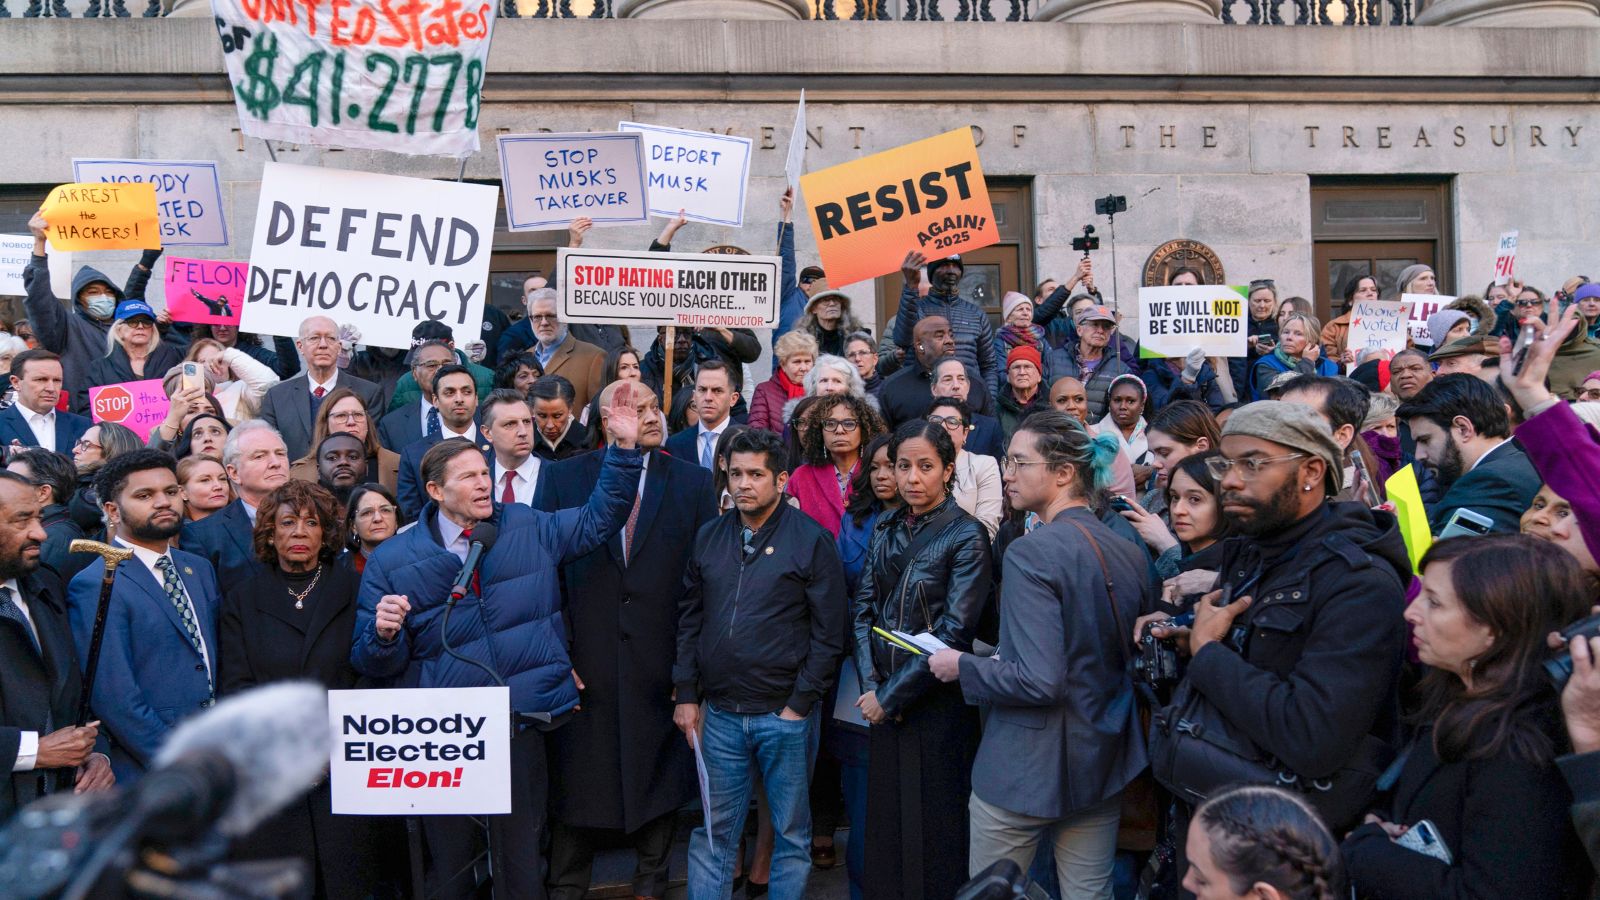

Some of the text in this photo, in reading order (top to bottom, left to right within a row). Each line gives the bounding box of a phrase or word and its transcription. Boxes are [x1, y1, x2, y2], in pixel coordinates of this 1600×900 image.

[1120, 126, 1217, 148] THE
[1304, 126, 1583, 148] TREASURY
[544, 148, 598, 168] STOP
[652, 144, 722, 167] DEPORT
[539, 168, 617, 190] MUSK'S
[649, 172, 708, 192] MUSK
[58, 188, 120, 203] ARREST
[535, 191, 629, 211] TAKEOVER
[815, 161, 972, 241] RESIST
[79, 209, 97, 220] the
[57, 222, 139, 241] HACKERS!
[266, 200, 480, 267] DEFEND
[917, 214, 986, 248] AGAIN!
[934, 231, 970, 250] 2025
[2, 241, 33, 250] NOBOD
[1, 257, 31, 265] ELECT
[574, 265, 767, 292] STOP HATING EACH OTHER
[247, 265, 480, 325] DEMOCRACY
[574, 290, 767, 311] BECAUSE YOU DISAGREE... TM
[1149, 301, 1240, 317] WE WILL NOT
[677, 313, 764, 327] TRUTH CONDUCTOR
[1149, 318, 1240, 335] BE SILENCED
[1362, 317, 1399, 331] voted
[96, 396, 130, 413] STOP
[138, 392, 158, 406] the
[343, 713, 487, 739] Nobody
[344, 740, 486, 762] Elected
[366, 767, 464, 789] Elon!
